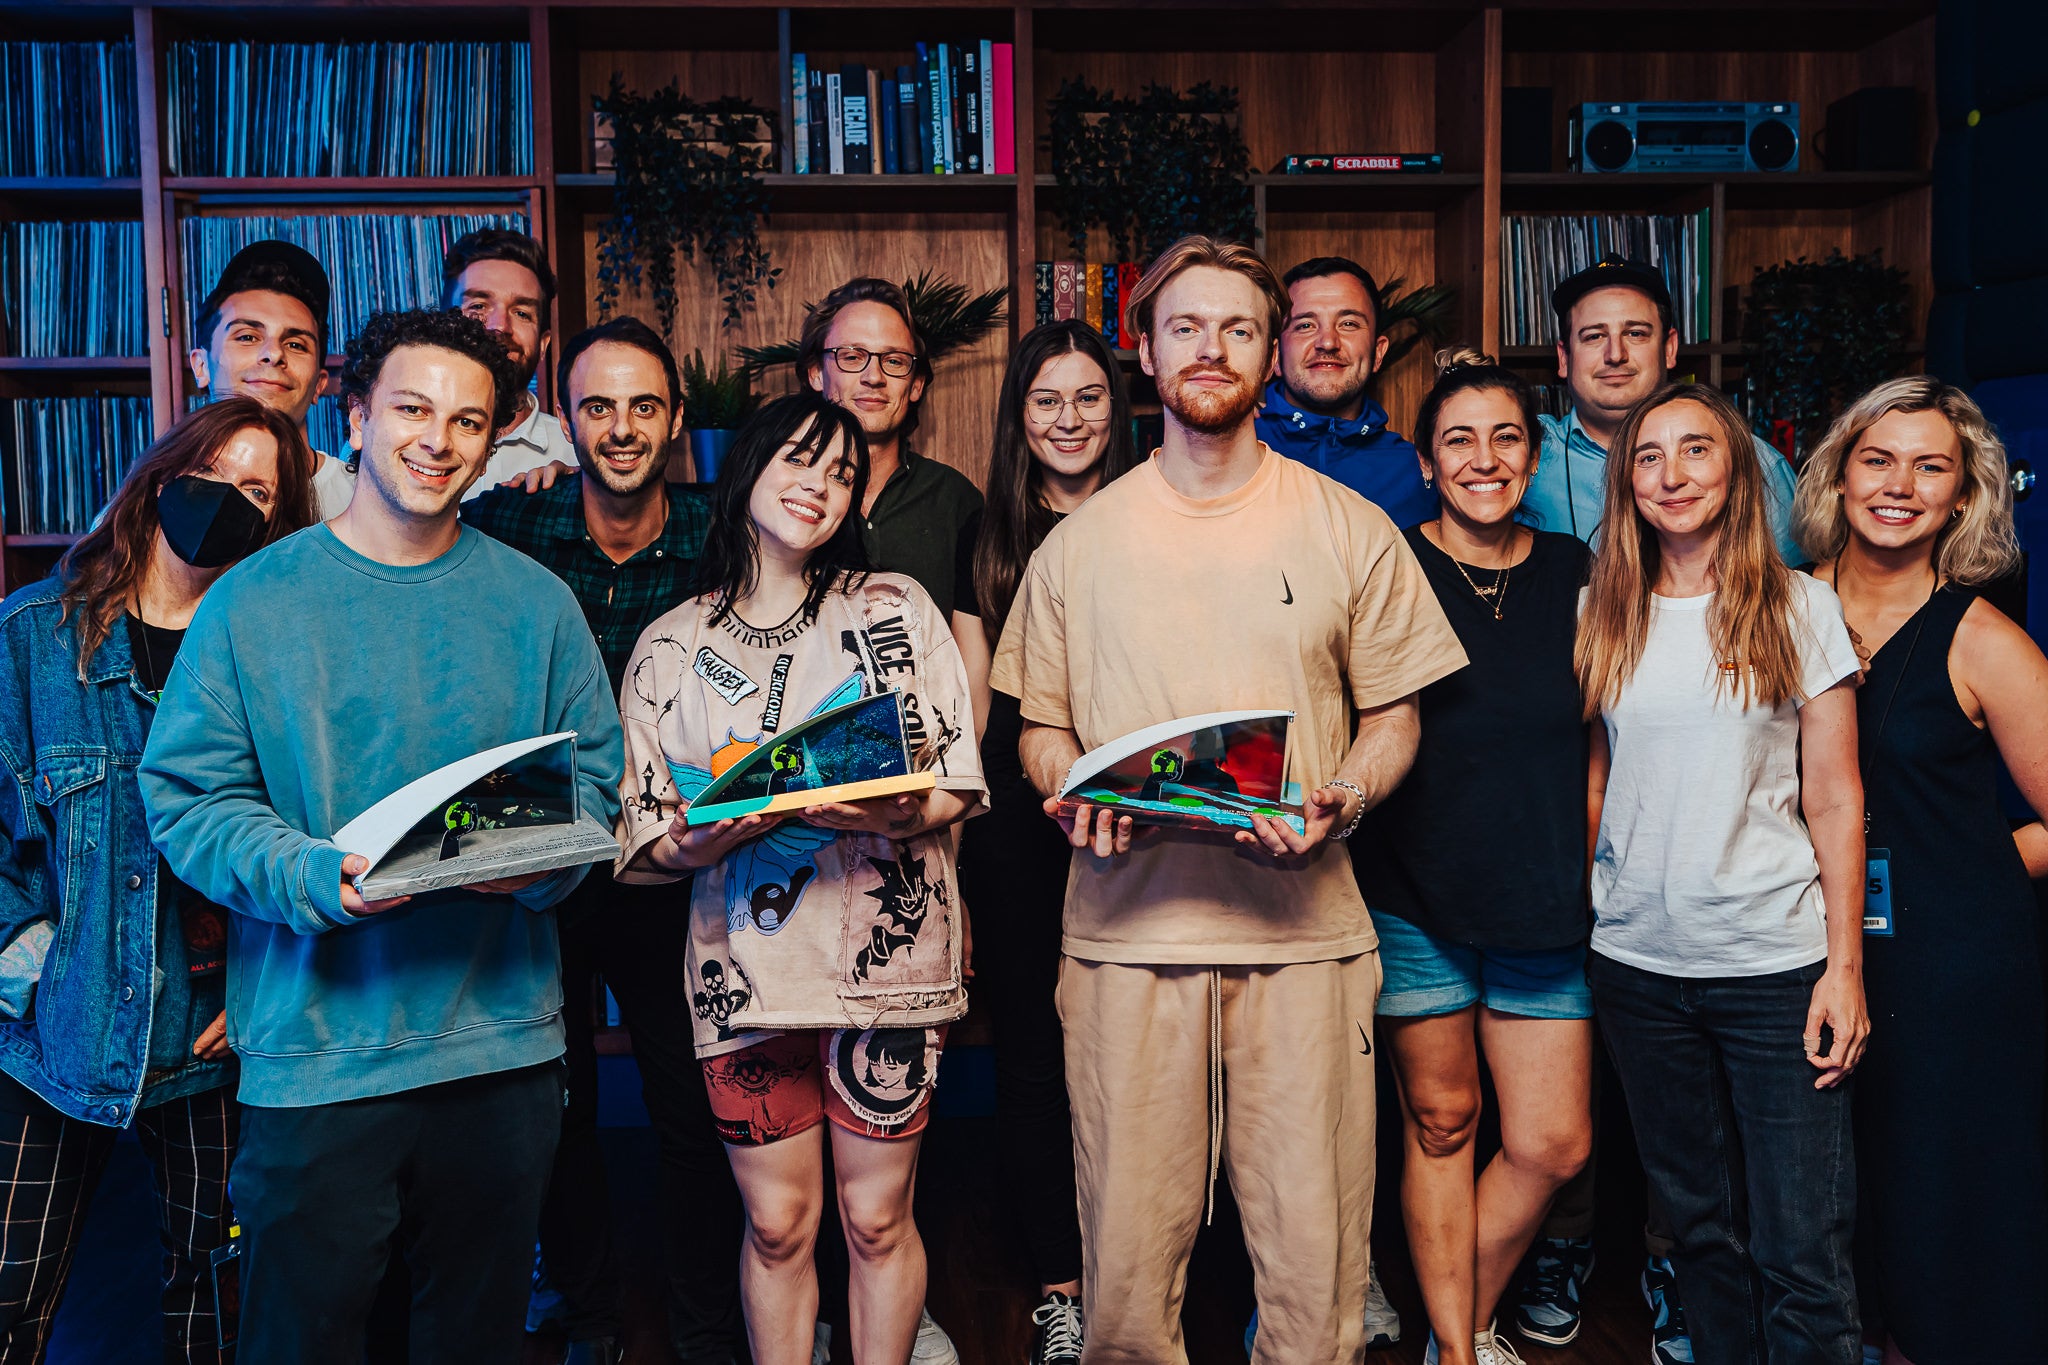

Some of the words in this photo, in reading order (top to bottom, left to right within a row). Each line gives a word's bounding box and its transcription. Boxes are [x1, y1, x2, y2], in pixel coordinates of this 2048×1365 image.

[843, 96, 867, 146] DECADE
[1336, 158, 1399, 169] SCRABBLE
[867, 615, 915, 676] VICE
[190, 963, 206, 973] ALL
[858, 1106, 891, 1122] forget
